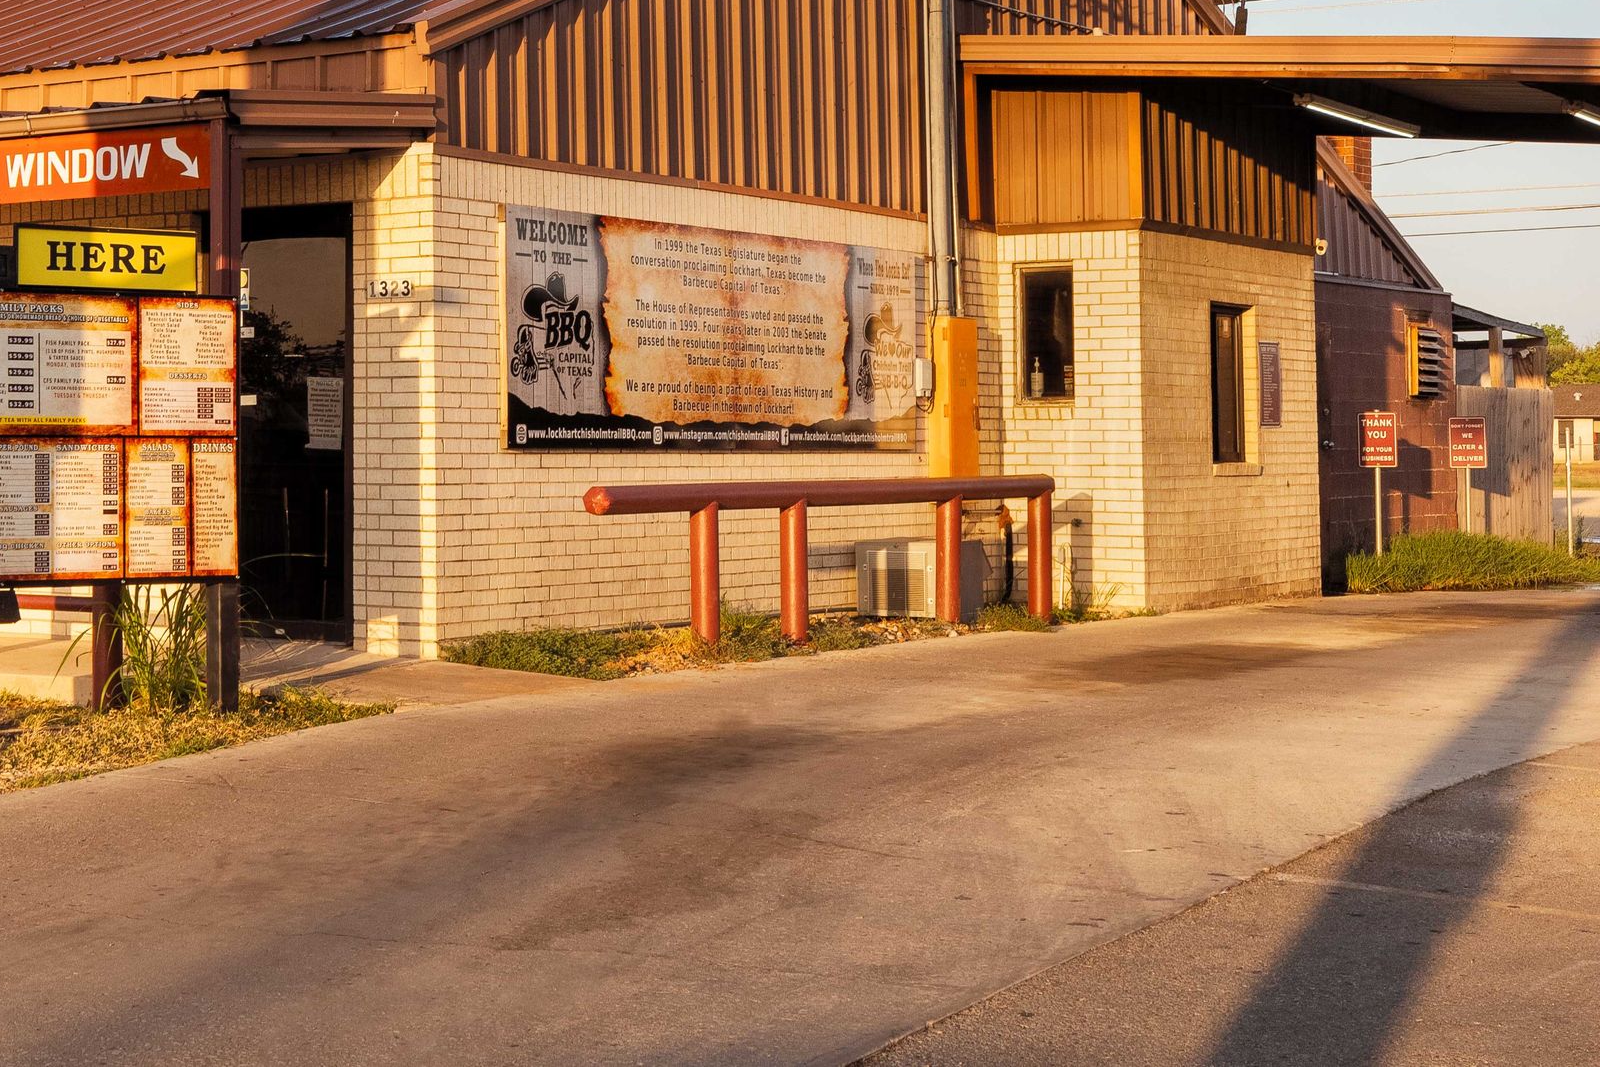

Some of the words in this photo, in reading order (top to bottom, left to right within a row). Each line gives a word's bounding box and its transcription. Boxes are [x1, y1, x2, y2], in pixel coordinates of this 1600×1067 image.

[5, 143, 151, 189] WINDOW
[516, 218, 588, 246] WELCOME
[46, 240, 167, 275] HERE
[534, 250, 547, 263] TO
[552, 252, 572, 265] THE
[655, 239, 662, 250] In
[665, 239, 683, 252] 1999
[686, 241, 698, 254] the
[700, 243, 721, 257] Texas
[725, 248, 765, 262] Legislature
[768, 252, 788, 266] began
[791, 254, 801, 265] the
[631, 254, 680, 269] conversation
[684, 261, 727, 275] proclaiming
[766, 268, 786, 279] Texas
[788, 269, 813, 282] become
[815, 272, 826, 283] the
[369, 280, 410, 298] 1323
[720, 279, 746, 293] Capital
[751, 282, 758, 293] of
[30, 304, 64, 313] PACKS
[636, 299, 650, 312] The
[653, 301, 676, 314] House
[679, 303, 687, 314] of
[689, 304, 748, 319] Representatives
[751, 308, 770, 320] voted
[773, 310, 785, 322] and
[788, 311, 811, 324] passed
[813, 313, 823, 324] the
[544, 310, 592, 351] BBQ
[627, 318, 667, 330] resolution
[670, 320, 676, 330] in
[703, 322, 719, 333] Four
[722, 325, 742, 335] years
[744, 323, 761, 336] later
[763, 325, 770, 336] in
[773, 326, 789, 338] 2003
[791, 328, 802, 339] the
[805, 329, 826, 340] Senate
[638, 335, 664, 348] passed
[667, 336, 680, 348] the
[682, 337, 720, 349] resolution
[723, 340, 765, 355] proclaiming
[767, 343, 795, 354] Lockhart
[797, 345, 804, 354] to
[806, 345, 813, 355] be
[815, 345, 825, 356] the
[559, 352, 591, 365] CAPITAL
[722, 356, 746, 369] Capital
[751, 357, 759, 368] of
[567, 366, 593, 377] TEXAS
[626, 379, 639, 392] We
[641, 381, 654, 392] are
[658, 380, 681, 394] proud
[684, 382, 693, 393] of
[694, 383, 715, 397] being
[719, 386, 723, 394] a
[726, 384, 742, 397] part
[744, 385, 752, 395] of
[754, 384, 768, 396] real
[771, 386, 791, 397] Texas
[794, 386, 818, 399] History
[821, 388, 833, 398] and
[673, 399, 709, 412] Barbecue
[712, 401, 719, 412] in
[722, 401, 733, 412] the
[735, 402, 752, 413] town
[755, 402, 762, 413] of
[764, 403, 794, 414] Lockhart!
[1361, 419, 1392, 427] THANK
[56, 444, 116, 452] SANDWICHES
[193, 443, 233, 453] DRINKS
